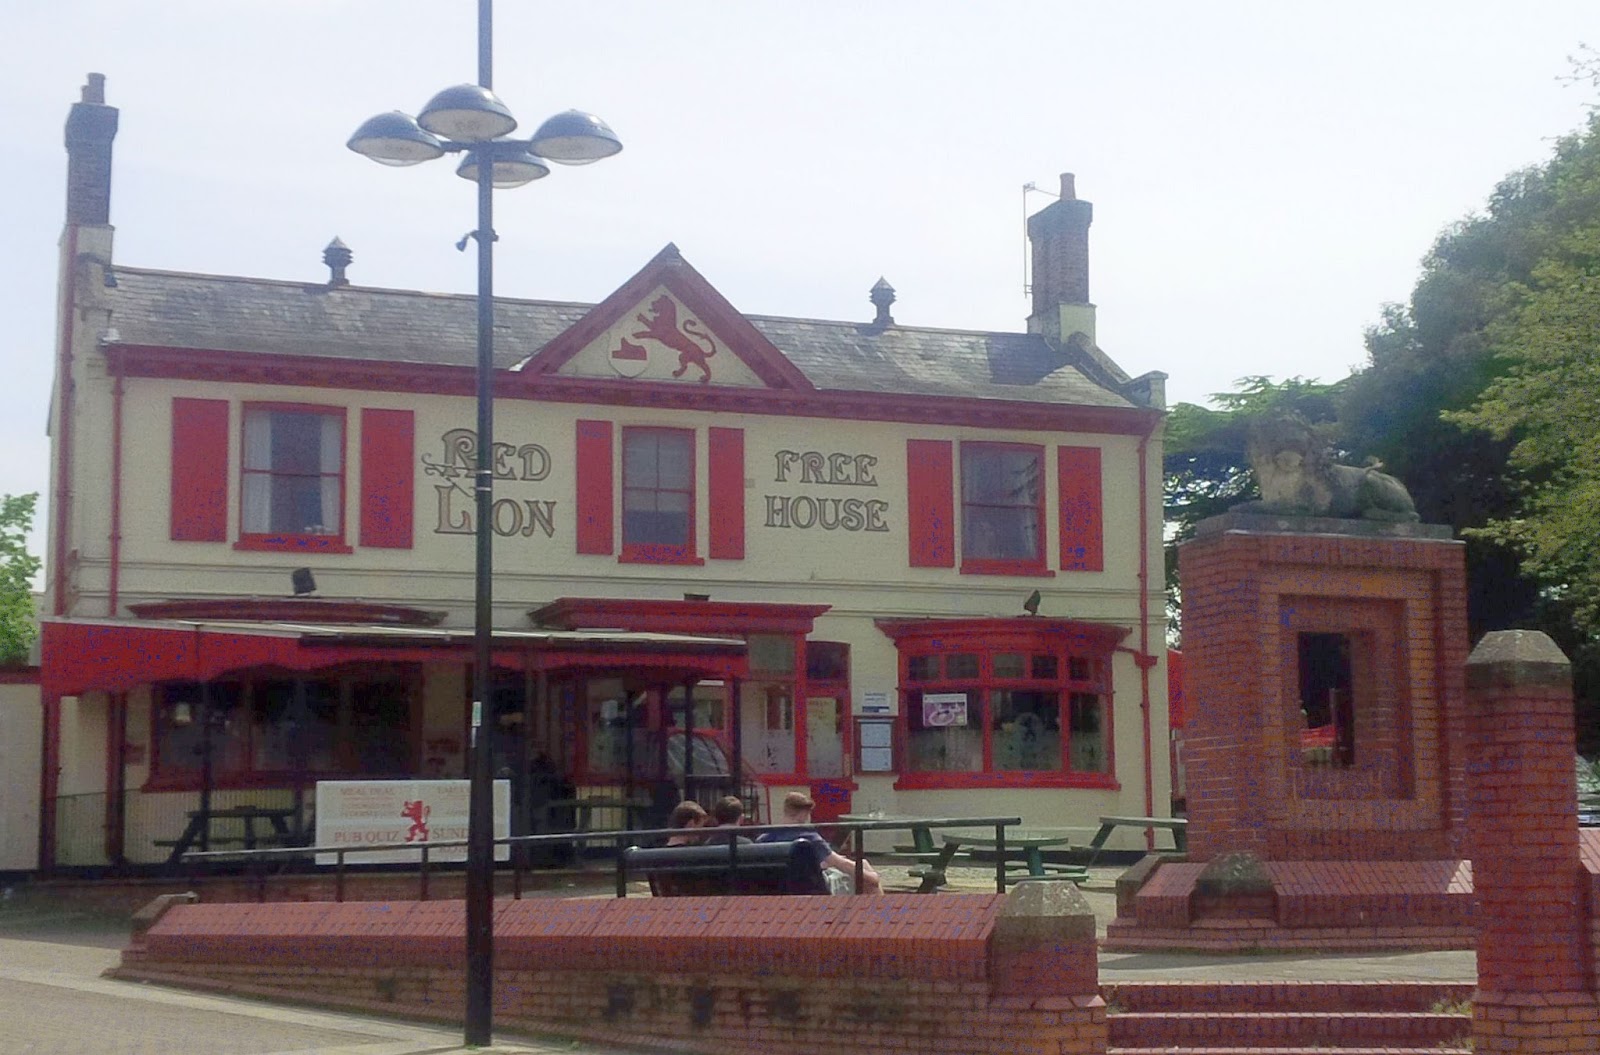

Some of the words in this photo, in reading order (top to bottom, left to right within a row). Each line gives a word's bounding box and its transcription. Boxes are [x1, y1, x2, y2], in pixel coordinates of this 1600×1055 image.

[440, 428, 552, 482] RED
[774, 450, 878, 487] FREE
[433, 484, 557, 538] LON
[764, 494, 889, 533] HOUSE
[334, 831, 362, 843] PUB
[365, 829, 400, 842] QUIZ
